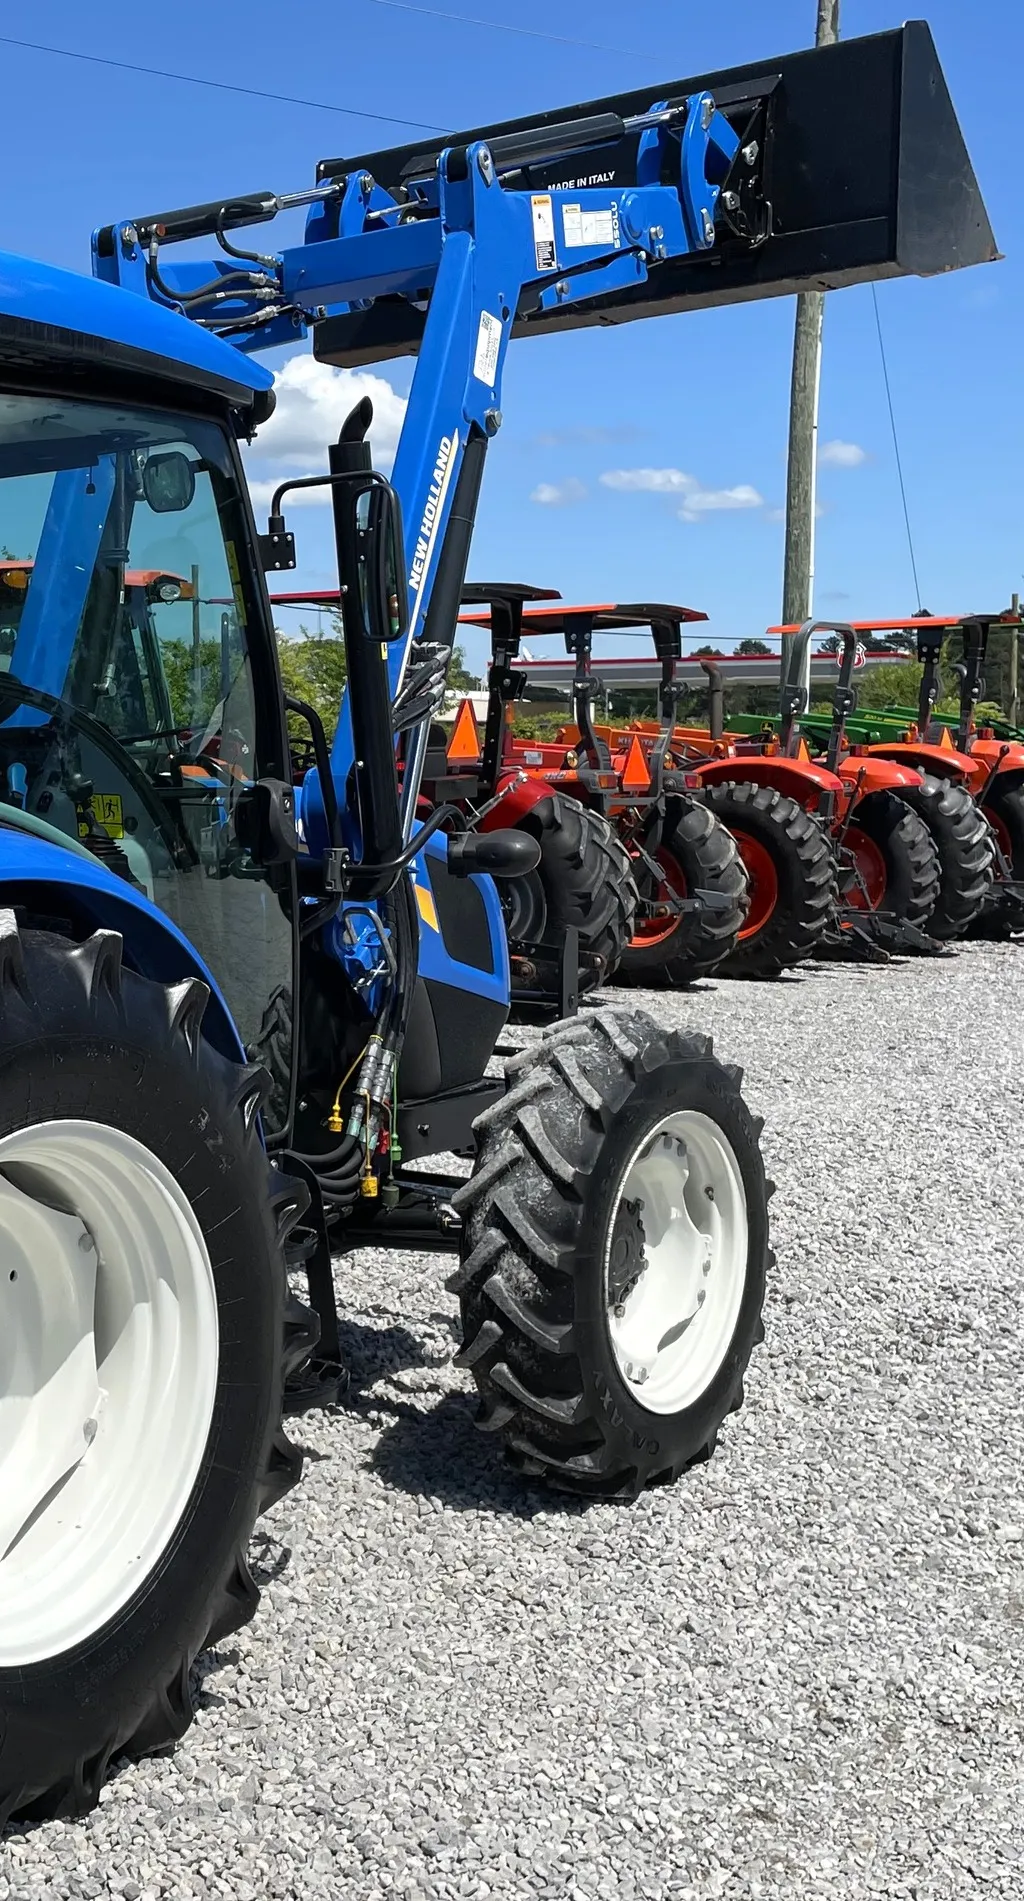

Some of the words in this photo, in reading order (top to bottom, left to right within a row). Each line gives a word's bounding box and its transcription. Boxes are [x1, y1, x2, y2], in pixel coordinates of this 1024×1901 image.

[547, 180, 575, 191] MADE
[577, 177, 587, 188] IN
[588, 171, 616, 185] ITALY
[408, 535, 427, 591] NEW
[420, 436, 452, 538] HOLLAND
